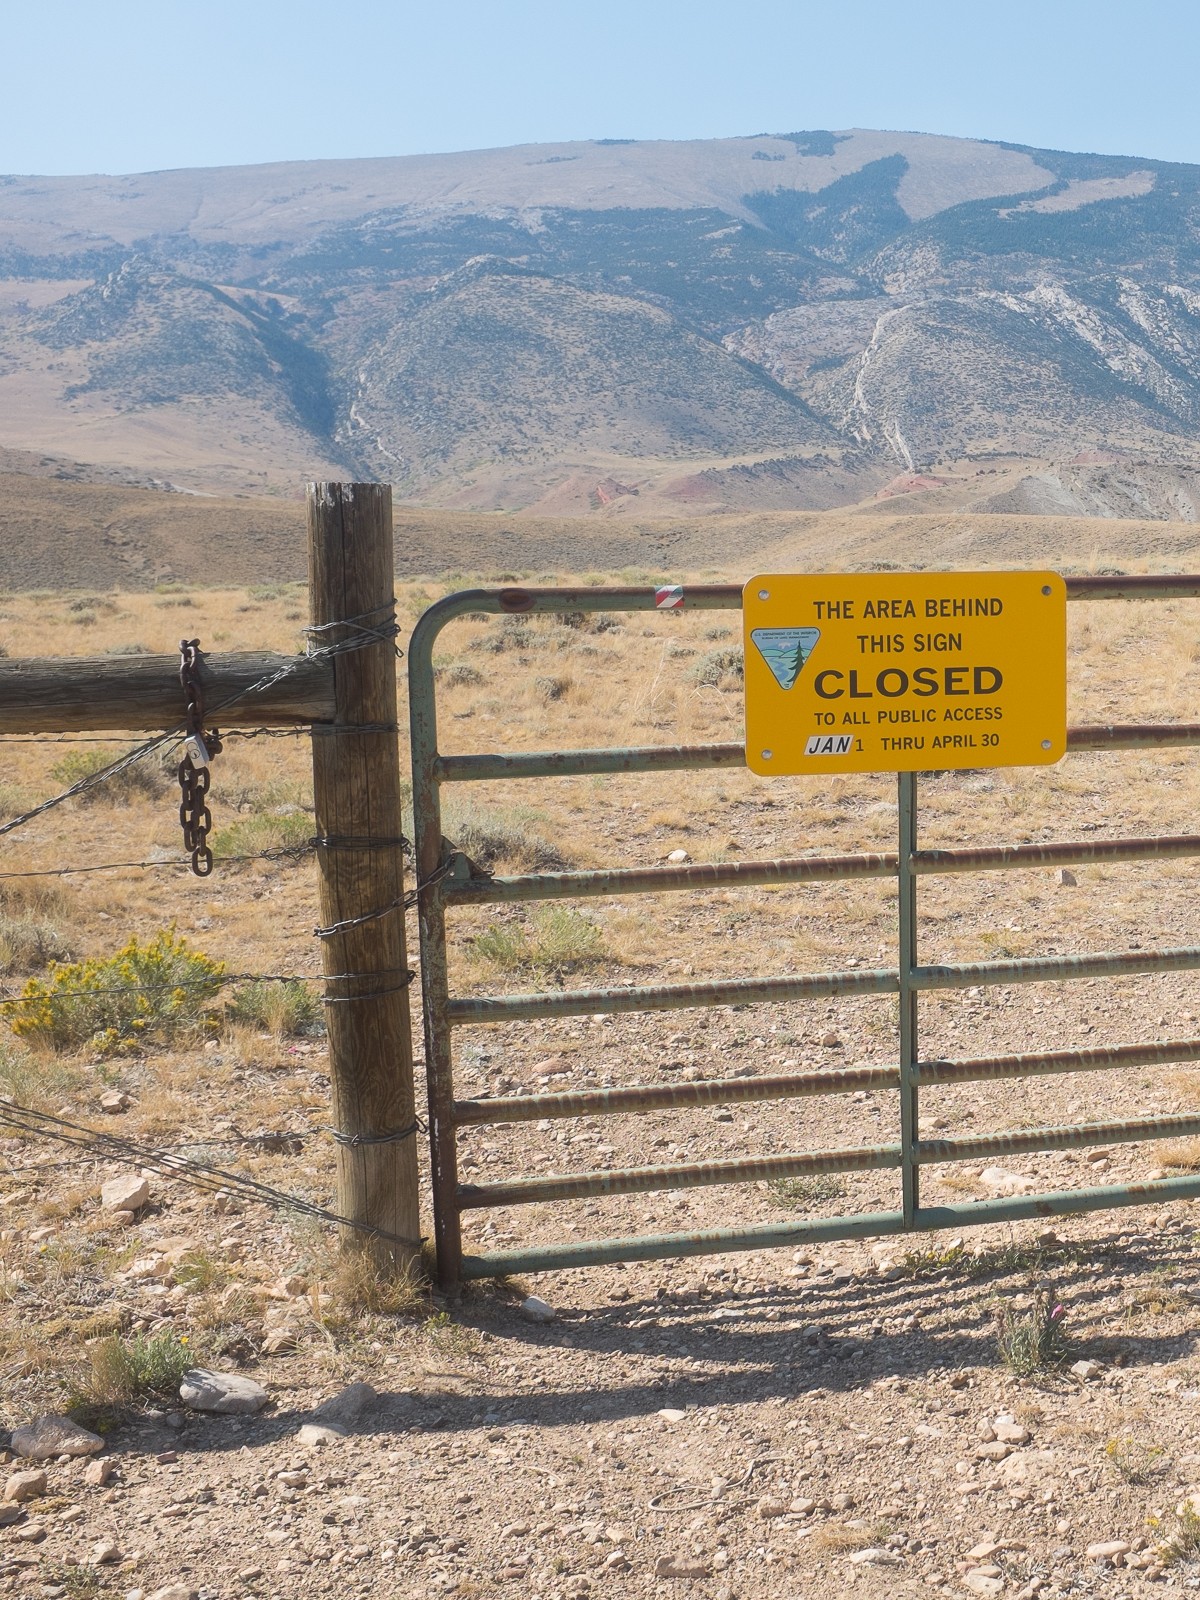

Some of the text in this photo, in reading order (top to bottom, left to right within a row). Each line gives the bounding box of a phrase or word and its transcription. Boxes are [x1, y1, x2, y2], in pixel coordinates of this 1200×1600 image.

[812, 597, 1003, 620] THE AREA BEHIND
[856, 632, 962, 654] THIS SIGN
[813, 666, 1004, 700] CLOSED
[813, 707, 1003, 726] TO ALL PUBLIC ACCESS
[808, 733, 1000, 755] JAN 1 THRU APRIL 30
